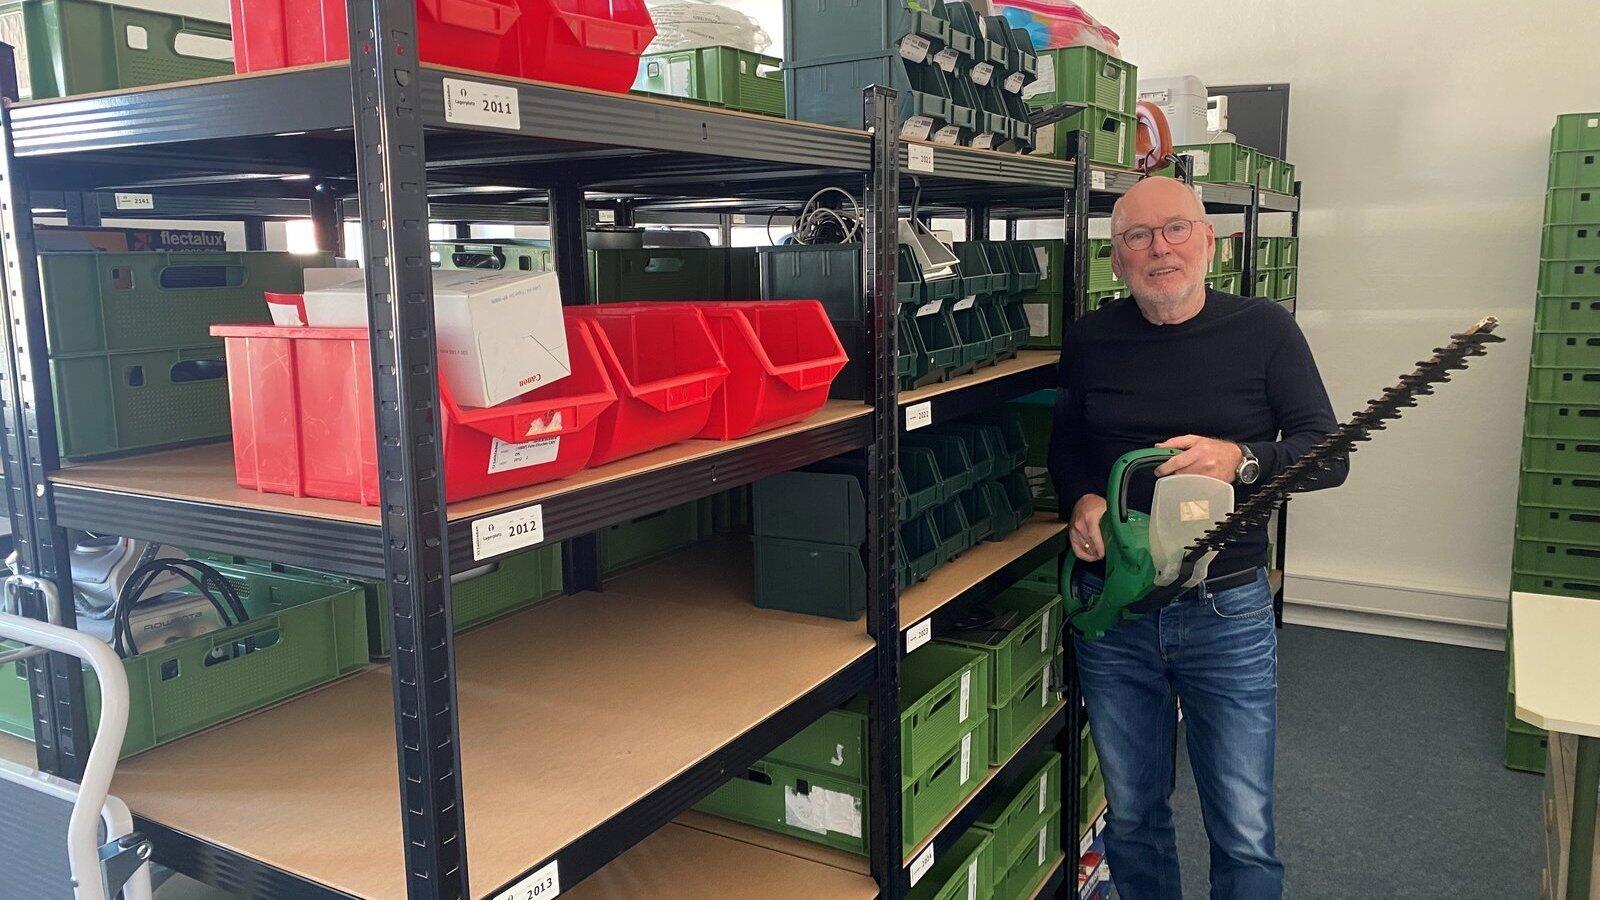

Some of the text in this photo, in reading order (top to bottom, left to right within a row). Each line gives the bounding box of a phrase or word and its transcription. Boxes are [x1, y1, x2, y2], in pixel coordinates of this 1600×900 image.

[482, 100, 512, 115] 2011
[160, 230, 223, 246] flectalux
[519, 373, 542, 387] Canon
[508, 520, 537, 538] 2012
[143, 612, 202, 632] ROWNTA
[526, 877, 553, 900] 2013
